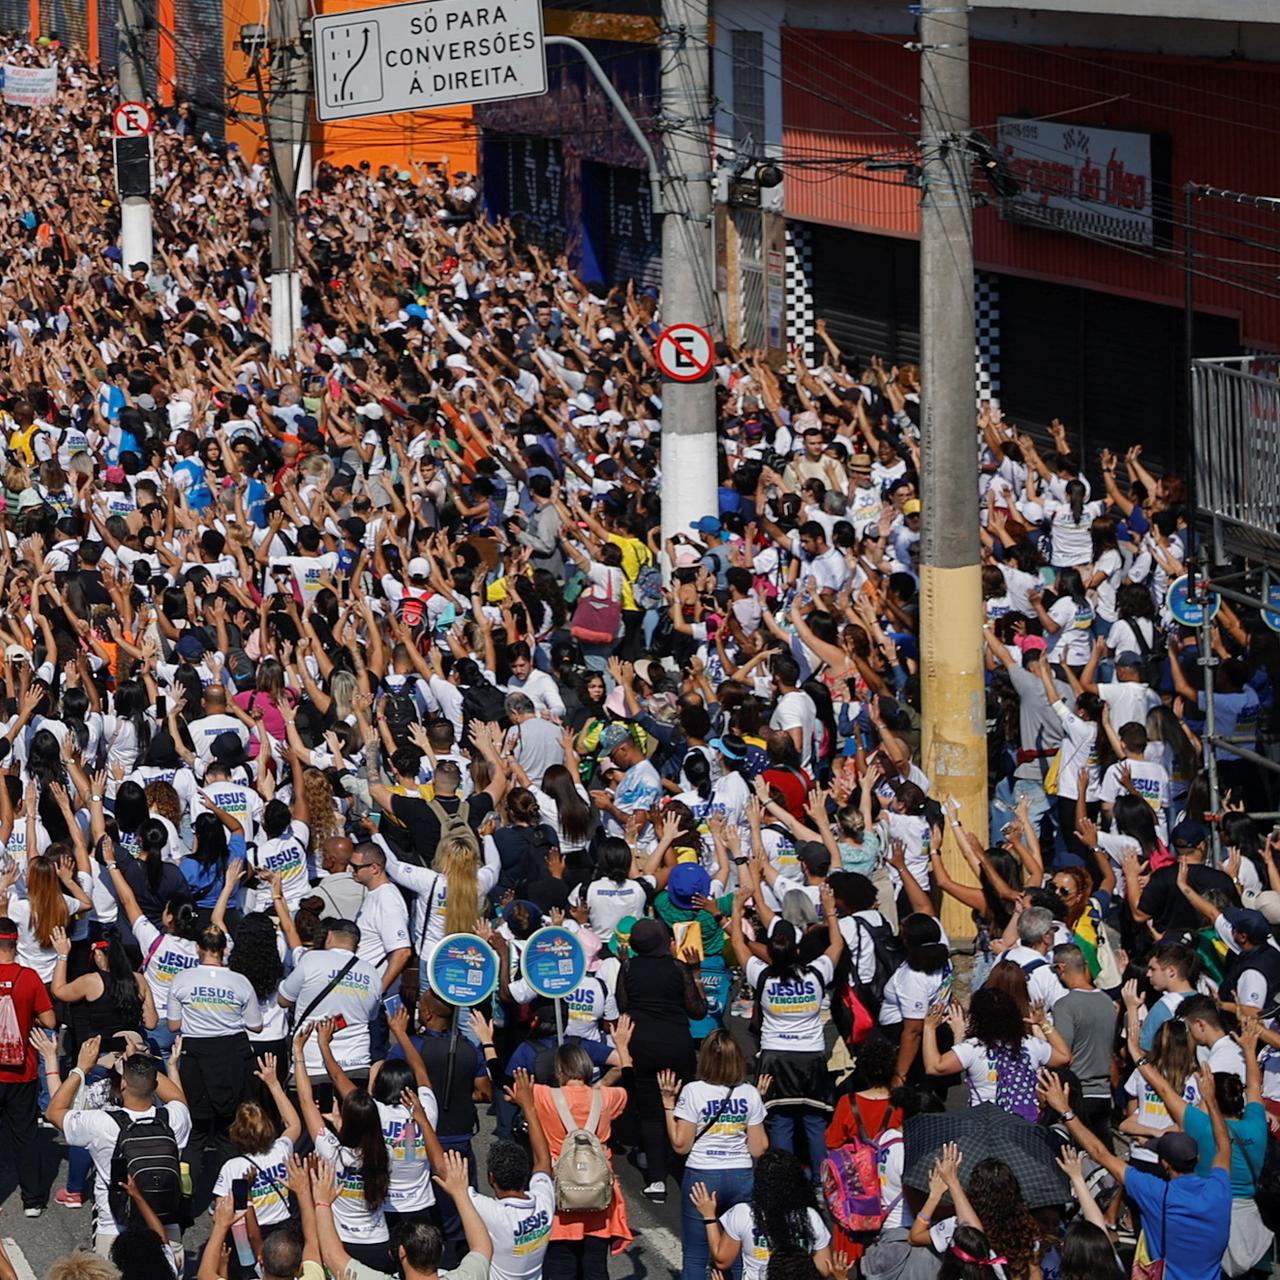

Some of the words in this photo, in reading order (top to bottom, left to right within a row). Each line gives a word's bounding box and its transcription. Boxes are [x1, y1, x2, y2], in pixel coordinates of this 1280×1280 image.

[410, 8, 437, 35] SÓ
[447, 6, 507, 30] PARA
[433, 65, 517, 91] DIREITA
[675, 337, 694, 367] E
[213, 793, 246, 805] JESUS
[264, 847, 300, 867] JESUS
[191, 986, 235, 998] JESUS
[768, 981, 815, 995] JESUS
[769, 993, 816, 1004] VENCEDOR
[513, 1211, 549, 1236] JESUS
